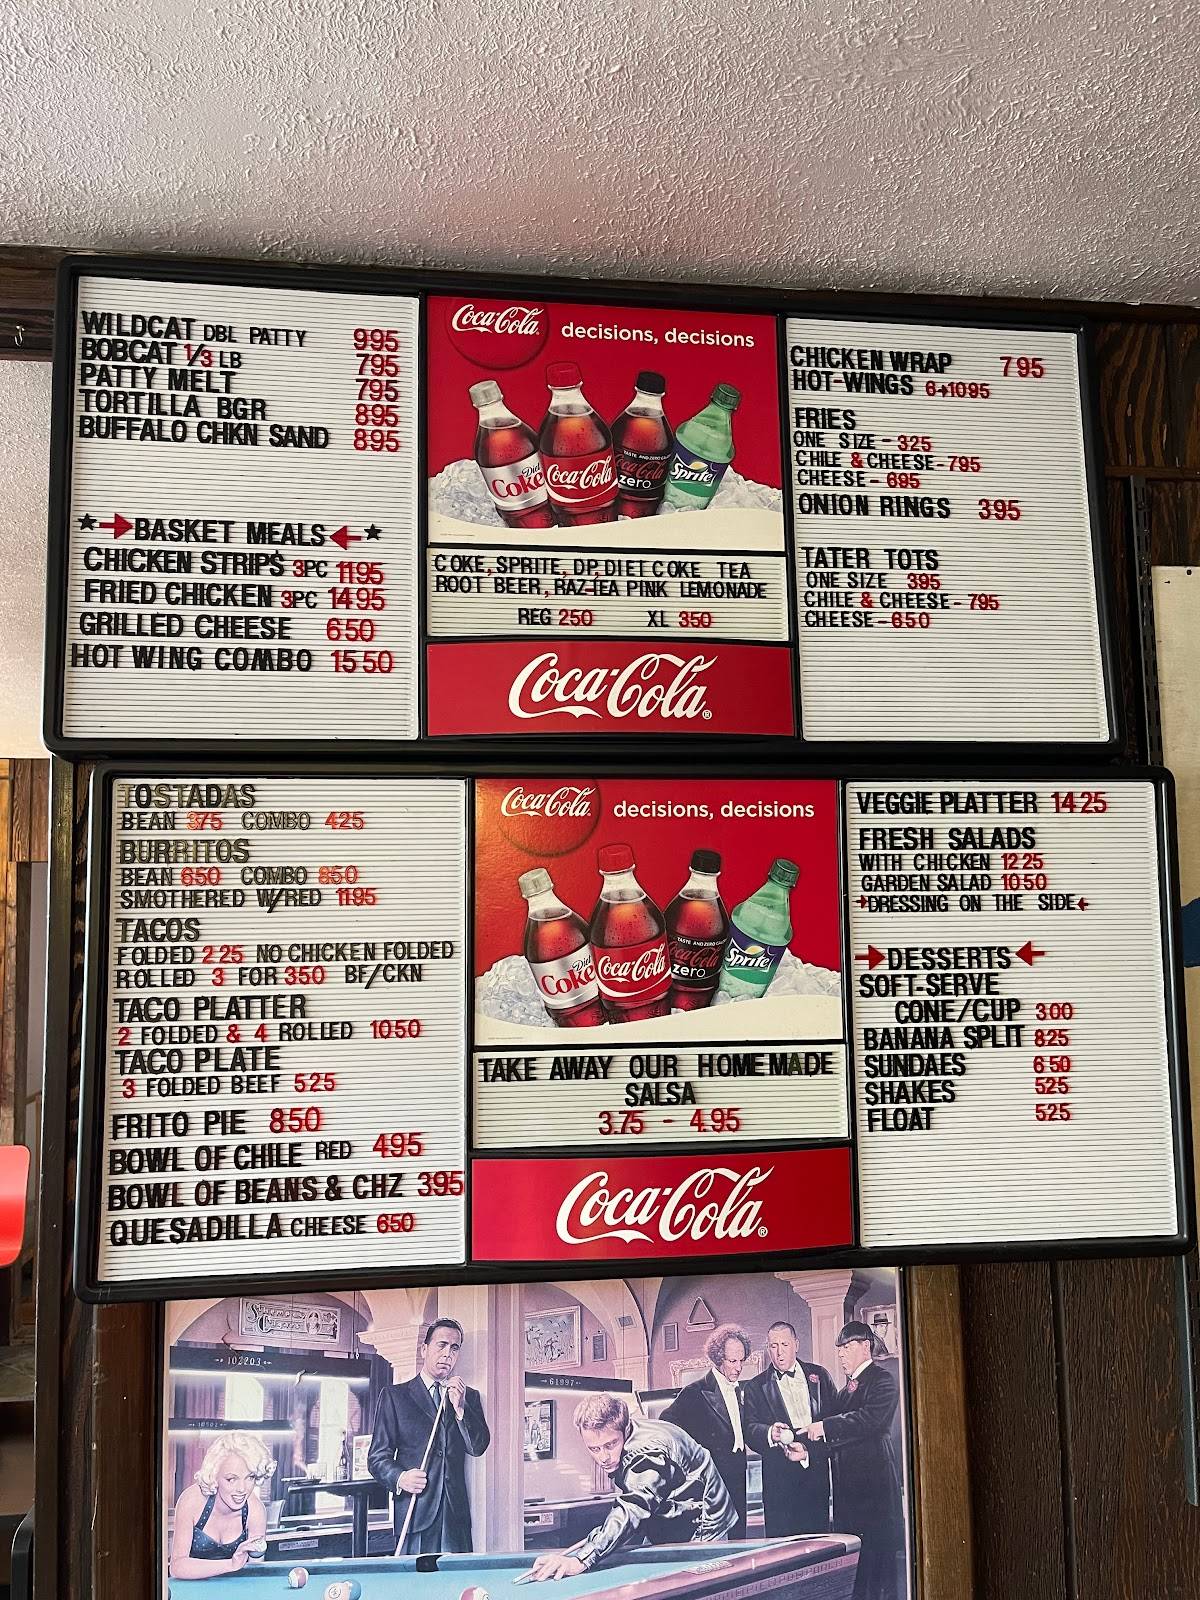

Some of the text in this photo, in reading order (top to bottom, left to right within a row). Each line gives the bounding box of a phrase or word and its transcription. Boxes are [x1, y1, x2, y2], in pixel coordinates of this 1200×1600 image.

[82, 311, 399, 352] WILDCAT DBL PATTY 995
[452, 304, 544, 335] Coca-Cola
[561, 322, 754, 347] decisions, decisions
[81, 338, 399, 377] BOBCAT LB 795
[790, 345, 1045, 378] CHICKEN WRAP 795
[80, 363, 398, 402] PATTY MELT 795
[793, 369, 914, 395] HOT-WINGS
[79, 389, 398, 427] TORTILLA BGR 895
[795, 407, 856, 430] FRIES
[79, 416, 399, 452] BUFFALO CHKN SAND 895
[793, 430, 875, 449] ONE SIZE
[795, 451, 842, 467] CHILE
[619, 474, 651, 488] zero
[670, 462, 712, 483] Sprite
[799, 493, 1021, 520] ONION RINGS 395
[135, 518, 325, 547] BASKET MEALS
[84, 547, 384, 585] CHICKEN STRIPS 1195
[801, 547, 939, 570] TATER TOTS
[435, 576, 767, 599] ROOT PINK LEMONADE
[806, 571, 941, 590] ONE SIZE 395
[84, 579, 385, 611] FRIED CHICKEN 1495
[804, 591, 853, 608] CHILE
[80, 612, 374, 642] GRILLED CHEESE 650
[518, 608, 713, 628] REG 250 XL 350
[72, 643, 393, 673] HOT WING COMBO 1550
[508, 653, 718, 719] Coca-Cola
[116, 784, 255, 808] TOSTADAS
[500, 786, 596, 818] Coca-Cola
[856, 792, 1107, 815] VEGGIE PLATTER 1425
[121, 811, 365, 830] BEAN COMBO 425
[614, 801, 814, 819] decisions, decisions
[859, 827, 1036, 850] FRESH SALADS
[119, 839, 250, 864] BURRITOS
[859, 853, 1043, 871] WITH CHICKEN 1225
[121, 866, 307, 886] BEAN 650 COMBO
[862, 874, 1047, 892] GARDEN SALAD 1050
[121, 888, 377, 909] SMOTHERED 1195
[868, 894, 1076, 913] DRESSING ON THE SIDE
[116, 917, 200, 943] TACOS
[118, 941, 453, 965] FOLDED 225 NO CHICKEN FOLDED
[725, 948, 770, 968] Sprite
[888, 947, 1012, 971] DESSERTS
[116, 965, 325, 988] ROLLED 3 FOR 350
[672, 963, 706, 978] zero
[114, 995, 306, 1023] TACO PLATTER
[1036, 1003, 1073, 1020] 300
[118, 1019, 421, 1046] 2 FOLDED 4 ROLLED 1050
[863, 1025, 1069, 1050] BANANA SPLIT 825
[114, 1046, 280, 1076] TACO PLATE
[478, 1057, 537, 1082] TAKE
[550, 1056, 613, 1080] AWAY
[629, 1054, 678, 1079] OUR
[864, 1053, 1071, 1078] SUNDAES 650
[122, 1073, 336, 1098] 3 FOLDED BEEF 525
[625, 1082, 696, 1107] SALSA
[865, 1077, 1069, 1105] SHAKES 525
[112, 1107, 320, 1140] FRITO PIE 850
[867, 1103, 1071, 1132] FLOAT 525
[109, 1133, 423, 1175] BOWL OF CHILE RED 495
[108, 1171, 464, 1211] BOWL OF BEANS CHZ 395
[555, 1166, 774, 1244] Coca-Cola
[110, 1213, 415, 1246] QUESADILLA CHEESE 650
